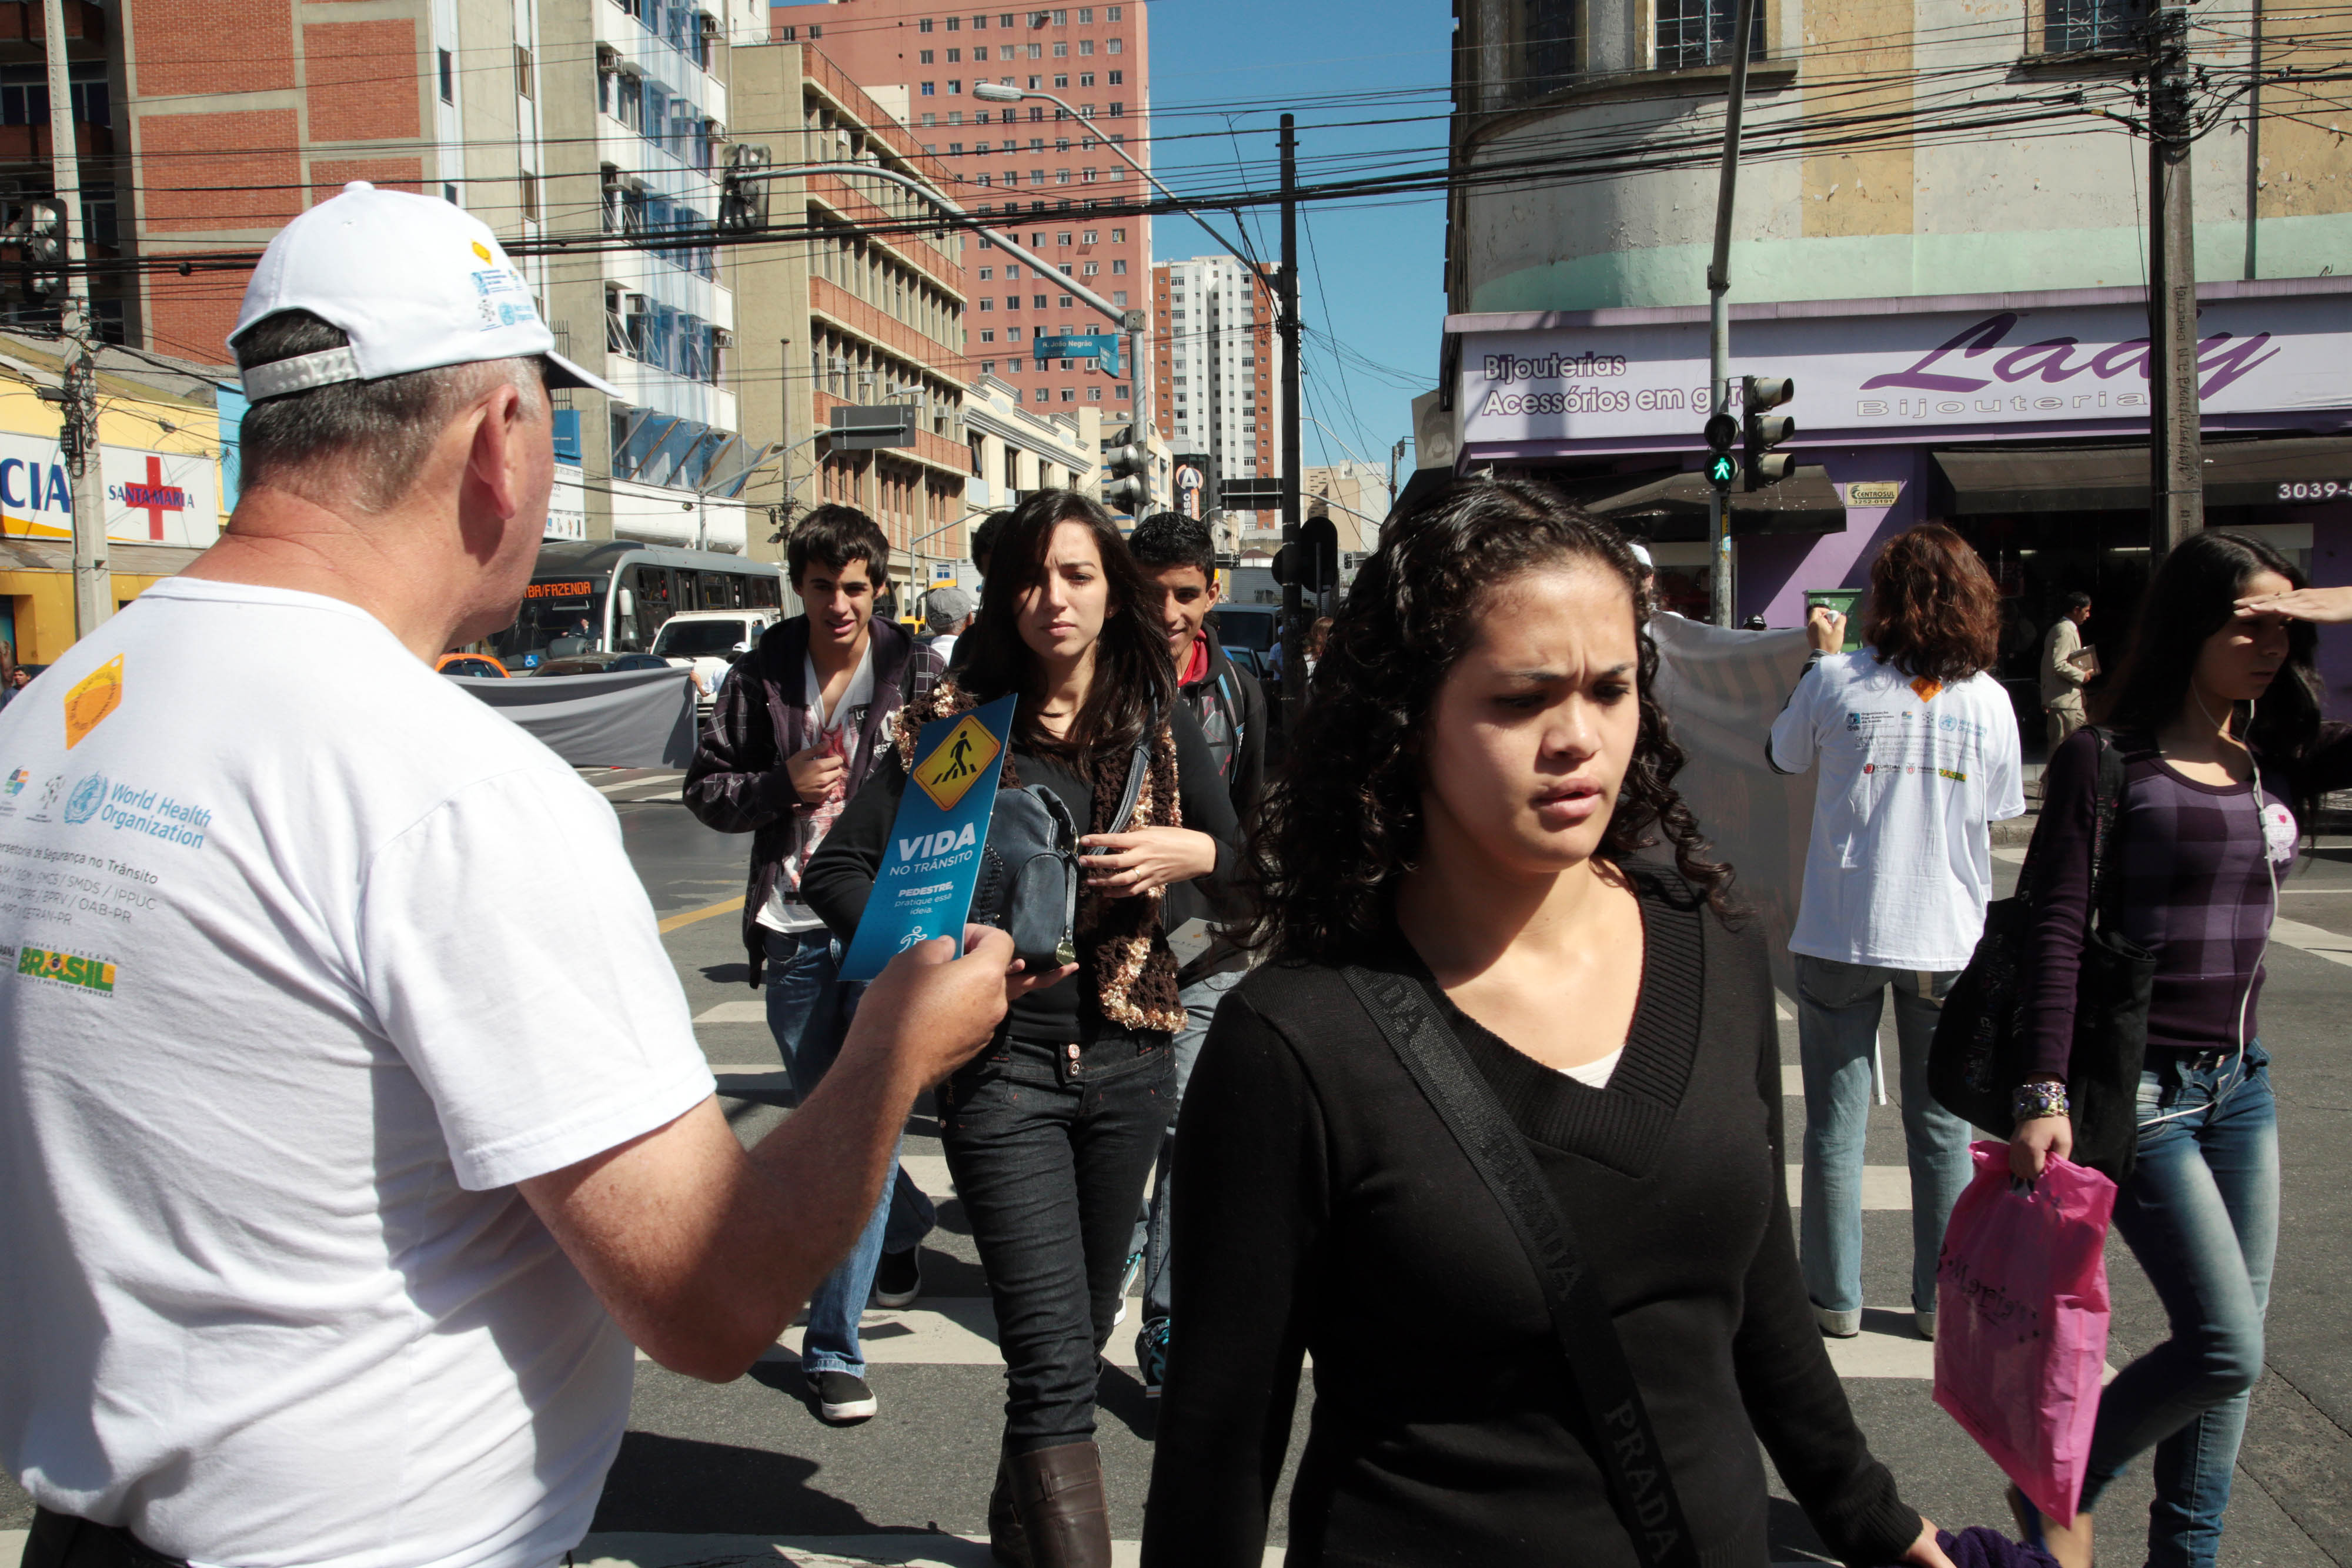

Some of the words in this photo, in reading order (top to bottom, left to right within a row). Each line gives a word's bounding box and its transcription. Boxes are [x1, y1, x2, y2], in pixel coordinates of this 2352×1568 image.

[1484, 351, 1626, 385] Bijouterias
[1859, 309, 2281, 401] Lady
[1482, 386, 1629, 415] Acessórios
[1636, 387, 1685, 410] em
[109, 484, 150, 504] SANTA
[151, 490, 195, 509] MARIA
[111, 783, 158, 811] World
[157, 797, 212, 828] Health
[101, 804, 205, 849] Organization
[898, 822, 975, 861] VIDA
[43, 848, 86, 864] Segurança
[89, 856, 104, 868] no
[107, 858, 159, 885] Trânsito
[889, 865, 910, 876] NO
[913, 850, 974, 873] TRÂNSITO
[67, 875, 101, 895] SMDS
[113, 887, 158, 911] IPPUC
[894, 897, 933, 908] pratique
[934, 893, 953, 903] essa
[898, 881, 954, 897] PEDESTRE,
[78, 897, 132, 924] OAB-PR
[910, 907, 933, 915] ideia.
[17, 946, 113, 992] BRASIL
[1600, 1397, 1681, 1564] PRADA
